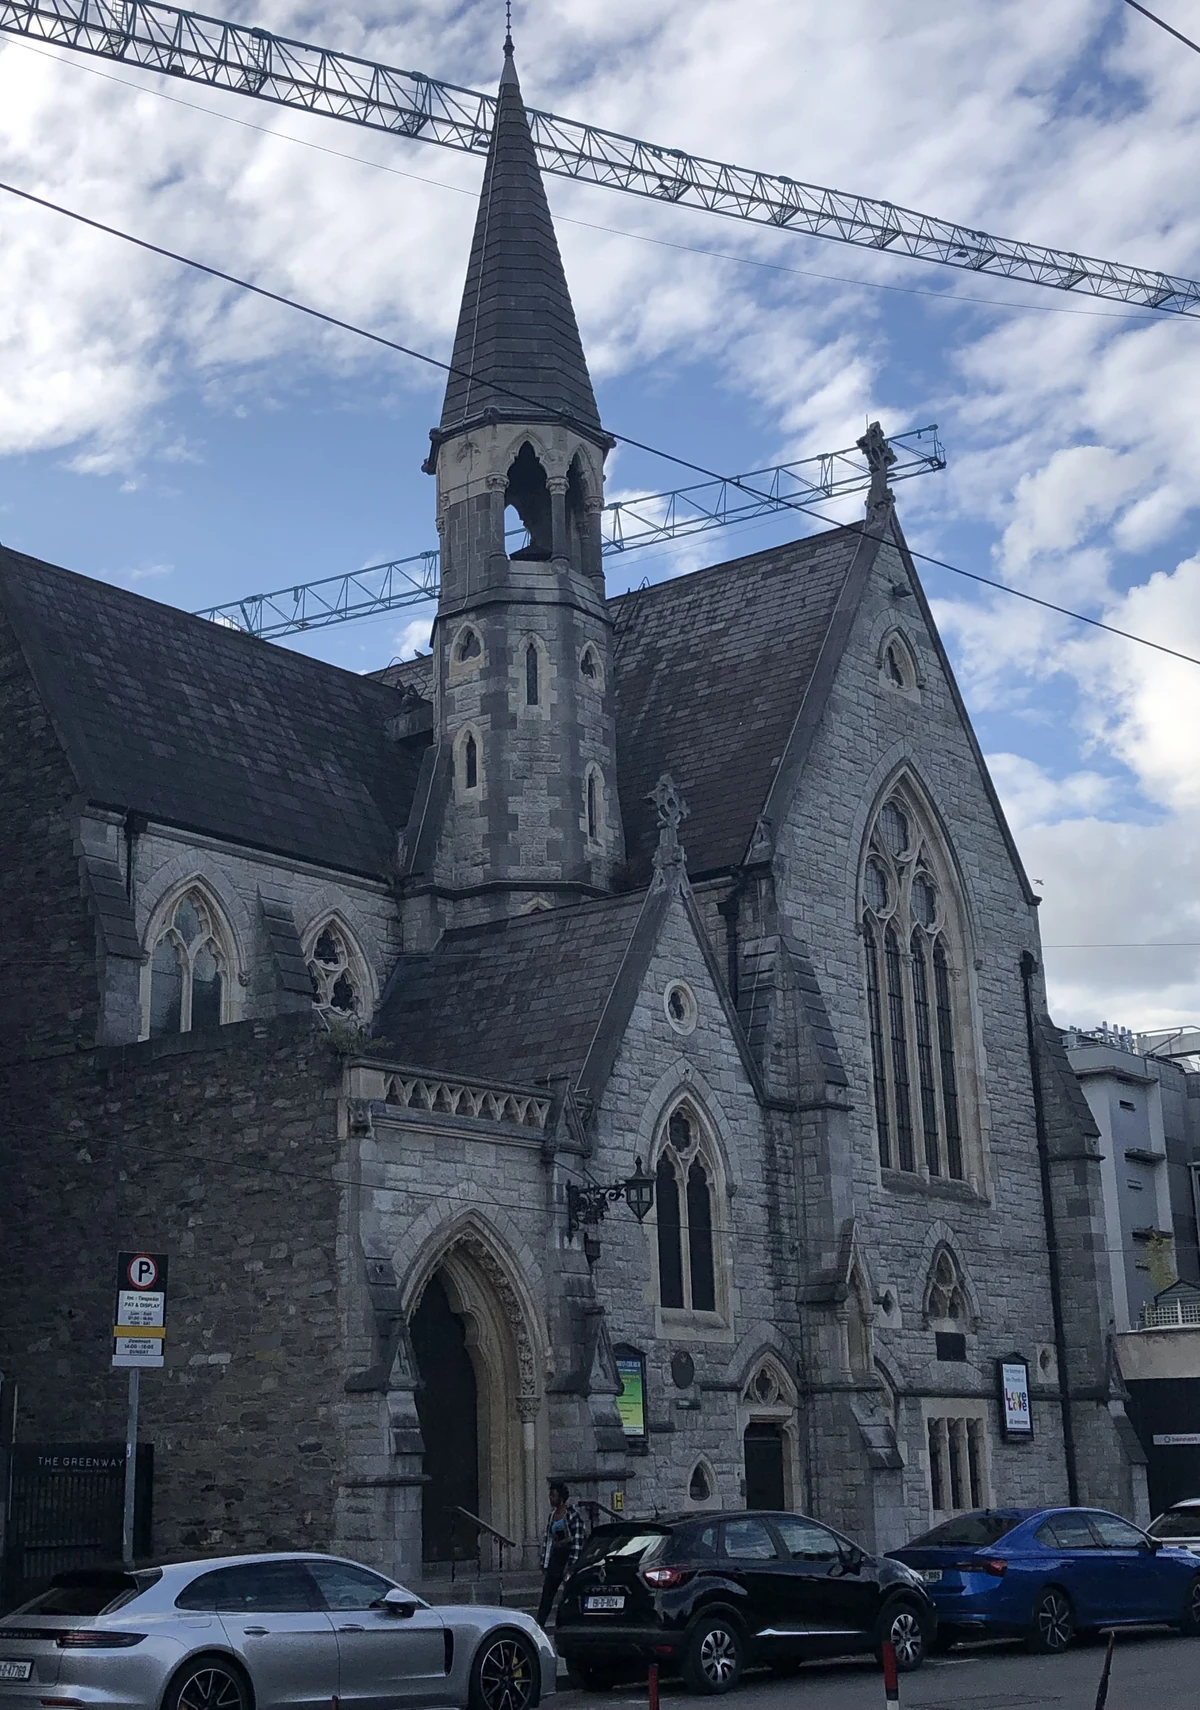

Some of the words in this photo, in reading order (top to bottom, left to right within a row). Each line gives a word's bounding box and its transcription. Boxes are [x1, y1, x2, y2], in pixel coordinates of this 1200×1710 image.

[139, 1261, 150, 1282] P
[1004, 1387, 1027, 1402] Love
[1007, 1400, 1028, 1412] Love
[38, 1456, 59, 1466] THE
[62, 1457, 124, 1467] GREENWAY
[616, 1494, 622, 1508] H
